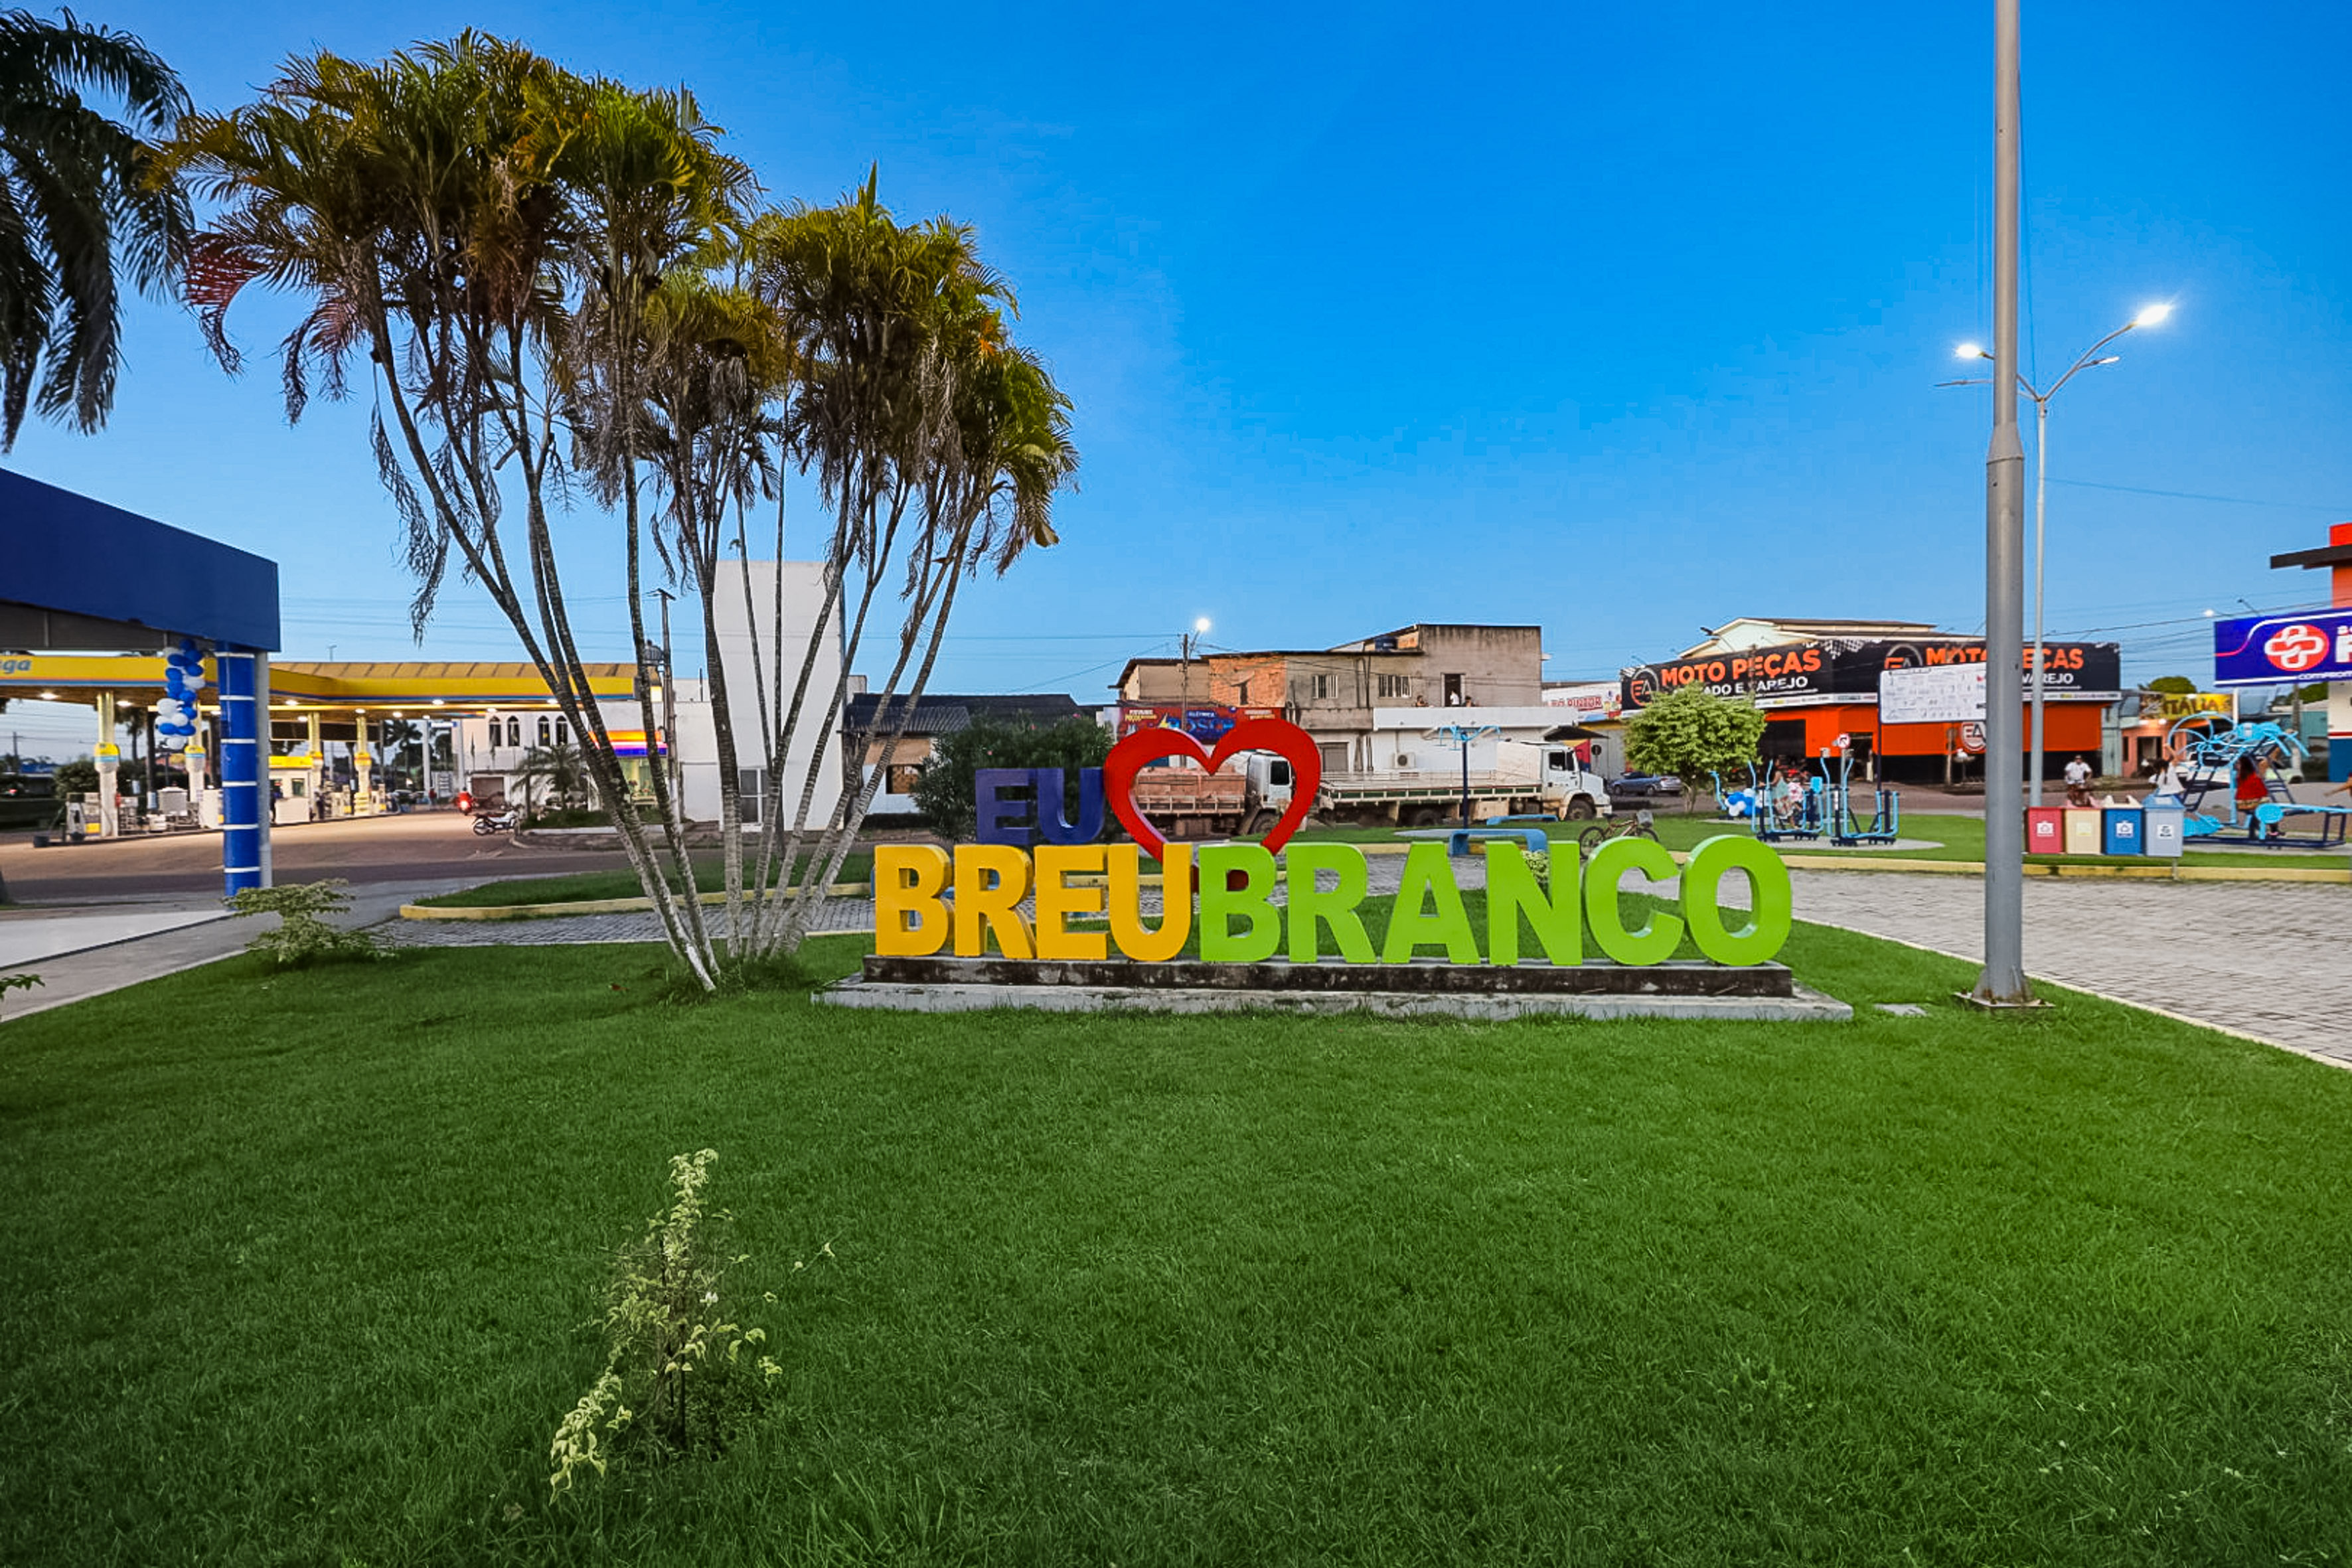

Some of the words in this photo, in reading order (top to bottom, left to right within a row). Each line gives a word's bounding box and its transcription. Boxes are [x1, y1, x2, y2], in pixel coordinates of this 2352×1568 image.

[1661, 661, 1726, 686] MOTO
[1732, 649, 1822, 680] PEÇAS
[975, 768, 1104, 844] EU
